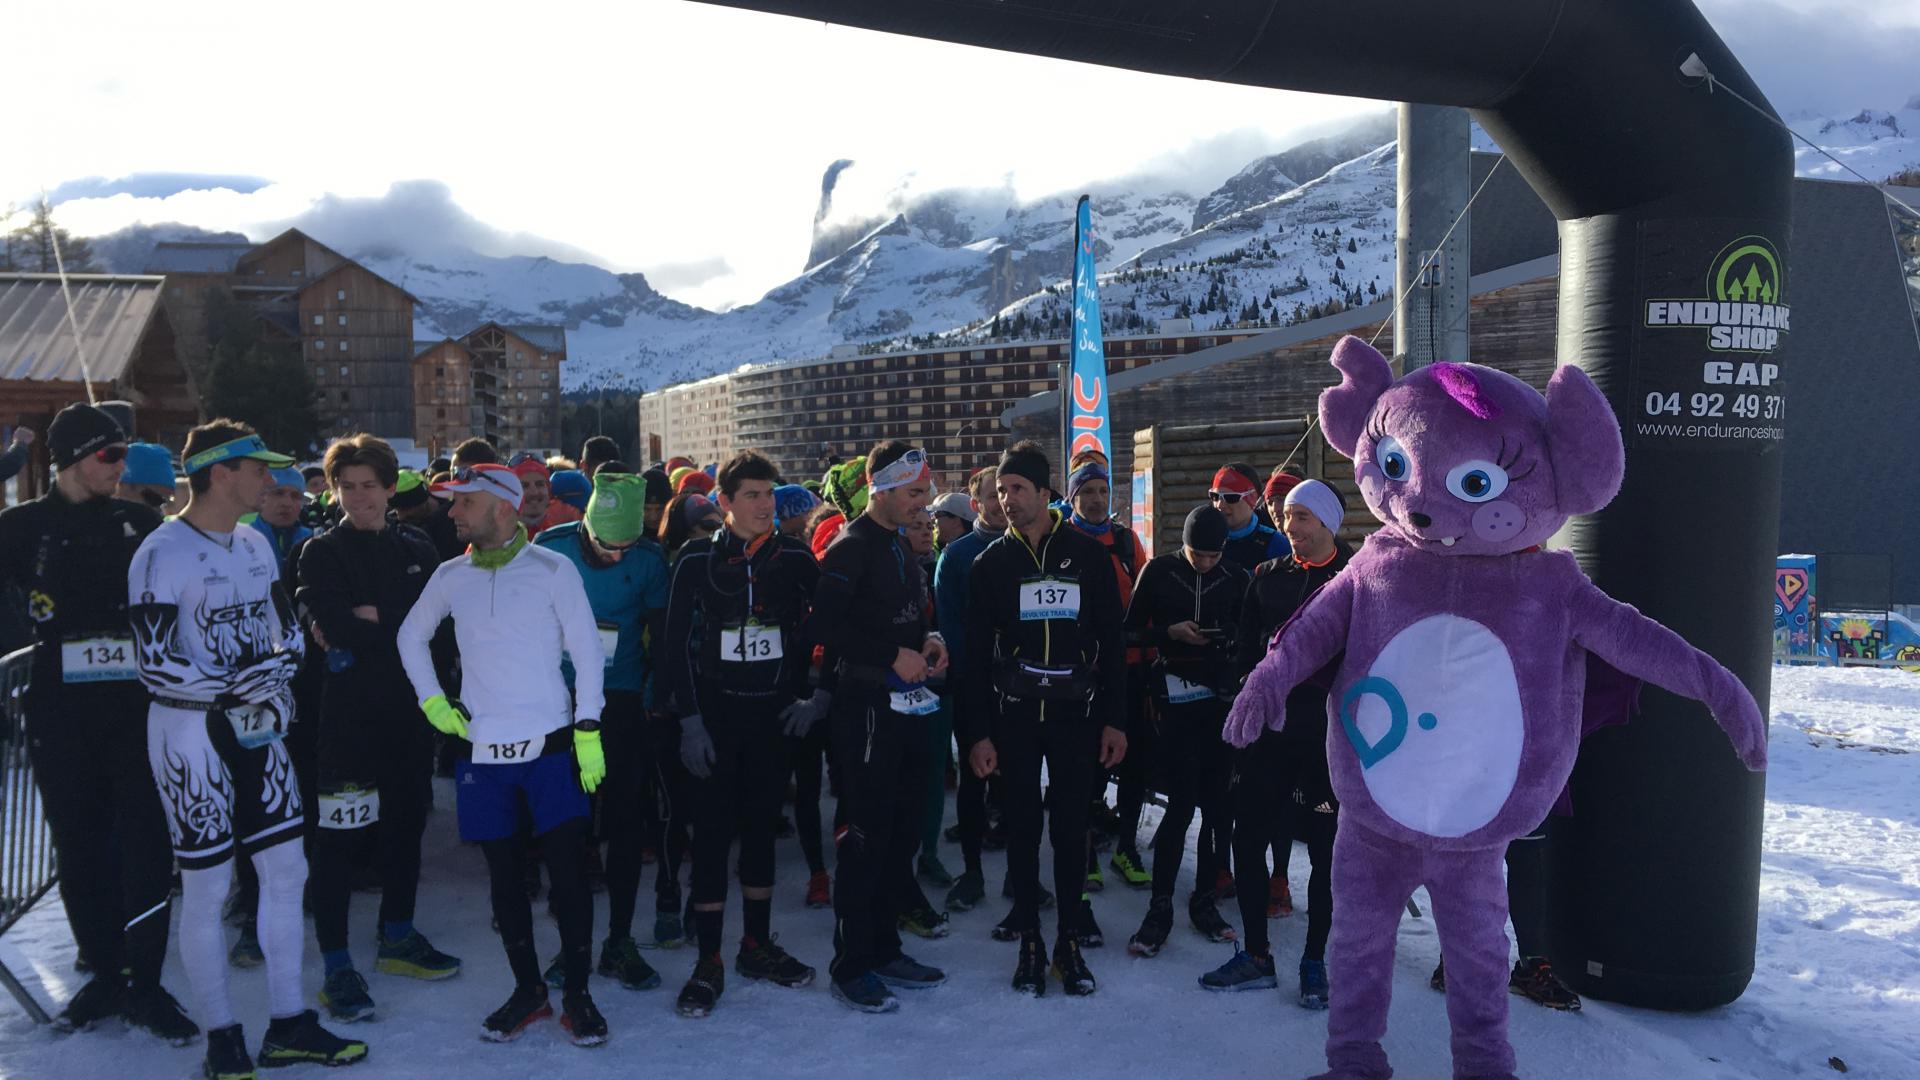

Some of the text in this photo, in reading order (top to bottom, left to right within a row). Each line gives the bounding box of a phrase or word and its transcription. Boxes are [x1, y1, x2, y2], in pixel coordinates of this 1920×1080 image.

[1710, 325, 1778, 350] SHOP
[1703, 361, 1779, 386] GAP
[1645, 391, 1682, 416] 04
[1690, 392, 1725, 417] 92
[1731, 393, 1760, 419] 49
[1034, 588, 1068, 605] 137
[82, 646, 126, 665] 134
[733, 638, 772, 657] 413
[488, 740, 531, 760] 187
[329, 804, 370, 825] 412
